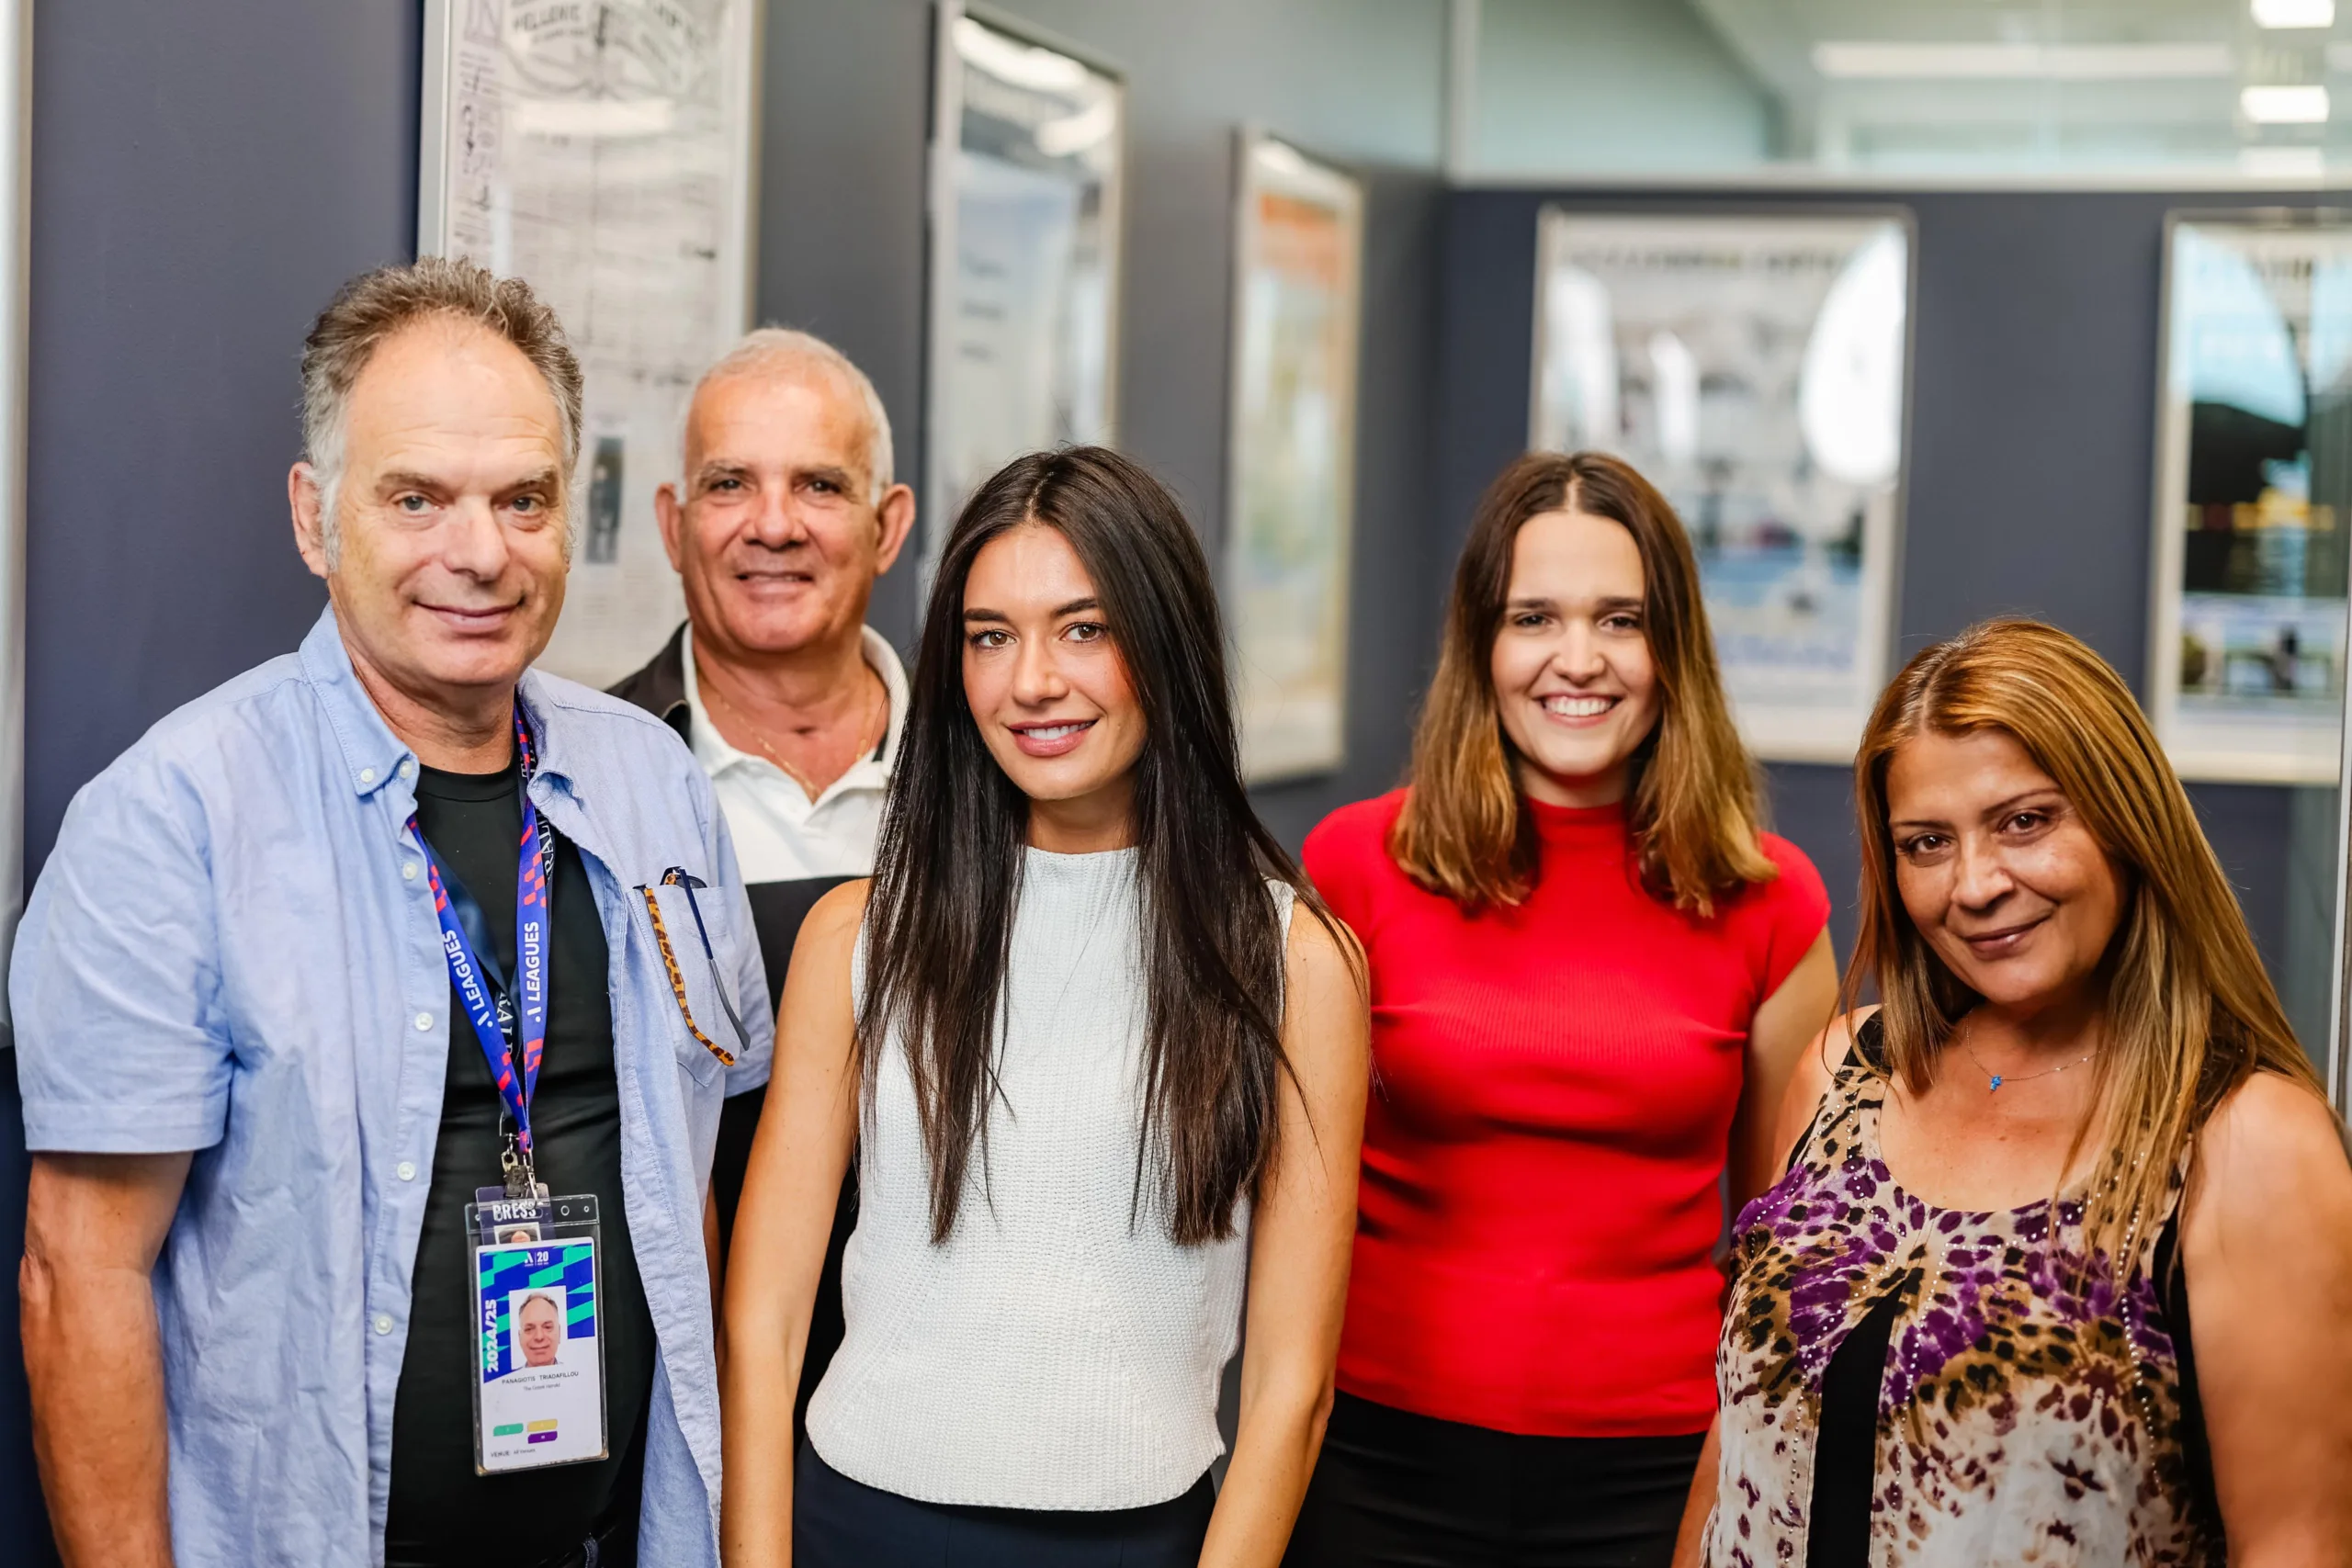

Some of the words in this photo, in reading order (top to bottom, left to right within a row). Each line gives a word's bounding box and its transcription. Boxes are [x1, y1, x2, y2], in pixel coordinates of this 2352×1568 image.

[442, 930, 485, 1011] LEAGUES
[524, 921, 540, 1002] LEAGUES
[492, 1202, 537, 1222] PRESS
[537, 1251, 549, 1263] 20
[485, 1299, 499, 1373] 2024/25
[502, 1376, 536, 1384] PANAGIOTIS
[539, 1371, 579, 1381] TRIADAFILLOU
